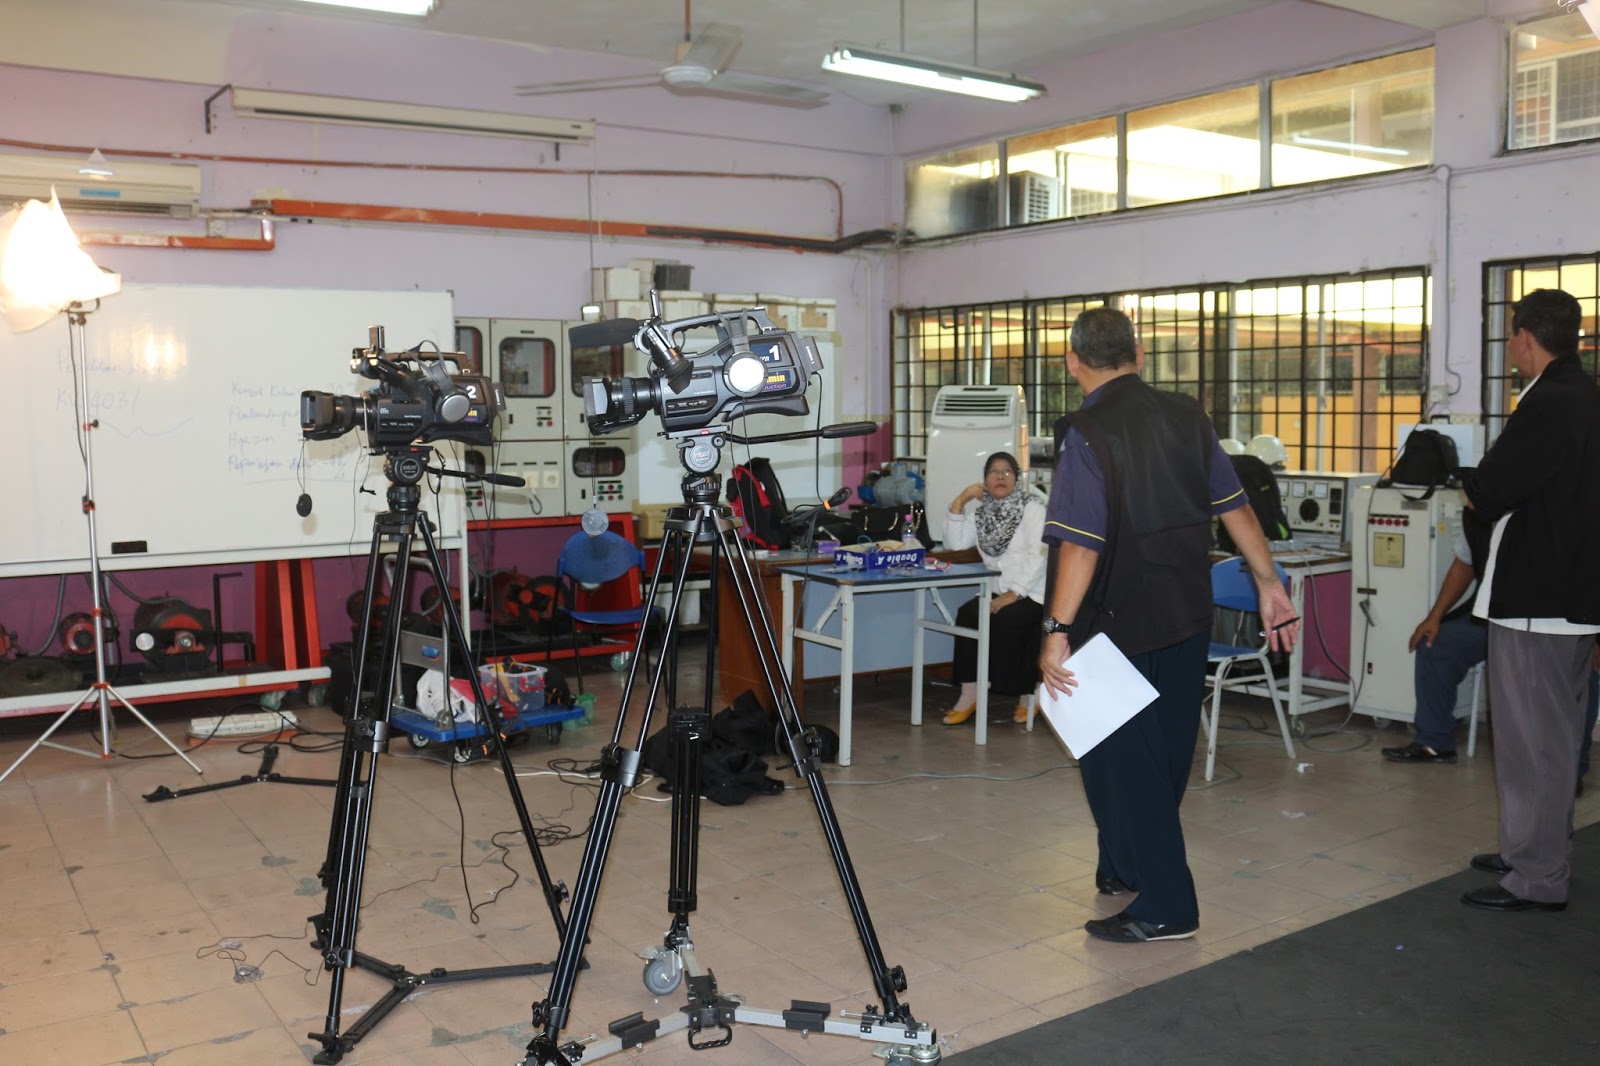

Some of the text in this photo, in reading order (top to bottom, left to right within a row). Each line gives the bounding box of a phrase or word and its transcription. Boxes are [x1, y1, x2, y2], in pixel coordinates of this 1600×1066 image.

[769, 344, 780, 361] 1
[465, 385, 477, 399] 2
[836, 553, 842, 561] A
[877, 552, 918, 565] Double A
